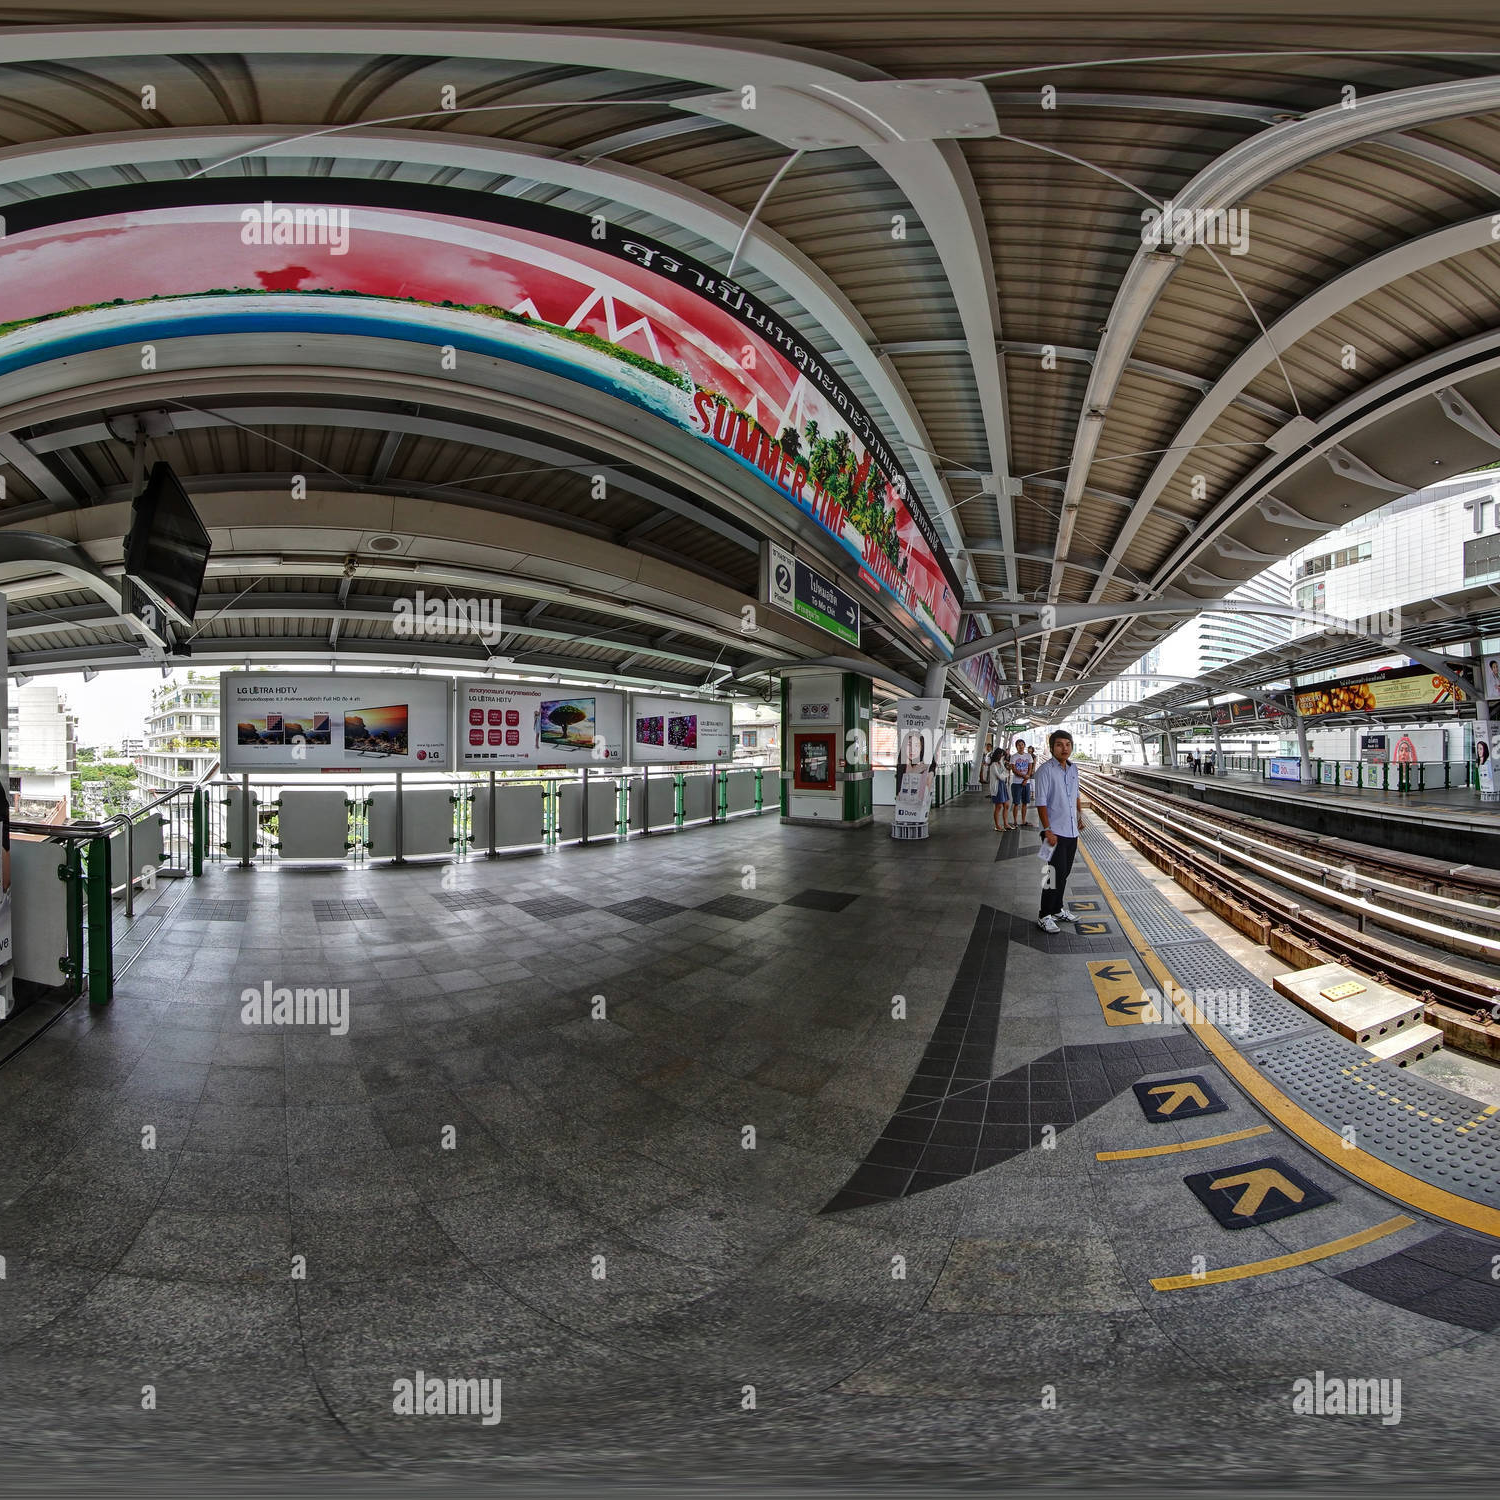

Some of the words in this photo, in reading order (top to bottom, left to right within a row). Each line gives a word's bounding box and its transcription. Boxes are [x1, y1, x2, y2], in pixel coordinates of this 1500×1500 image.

[692, 390, 809, 505] SUMMER
[812, 479, 850, 541] TIME
[779, 566, 788, 592] 2
[861, 534, 904, 601] SMIRNOFF
[809, 572, 838, 607] ไปหมอชิต
[811, 596, 818, 606] To
[818, 601, 827, 611] Mo
[827, 605, 836, 617] Chit
[249, 686, 274, 695] ULTRA
[275, 687, 298, 695] HDTV
[428, 751, 440, 759] LG
[904, 809, 918, 818] Dove
